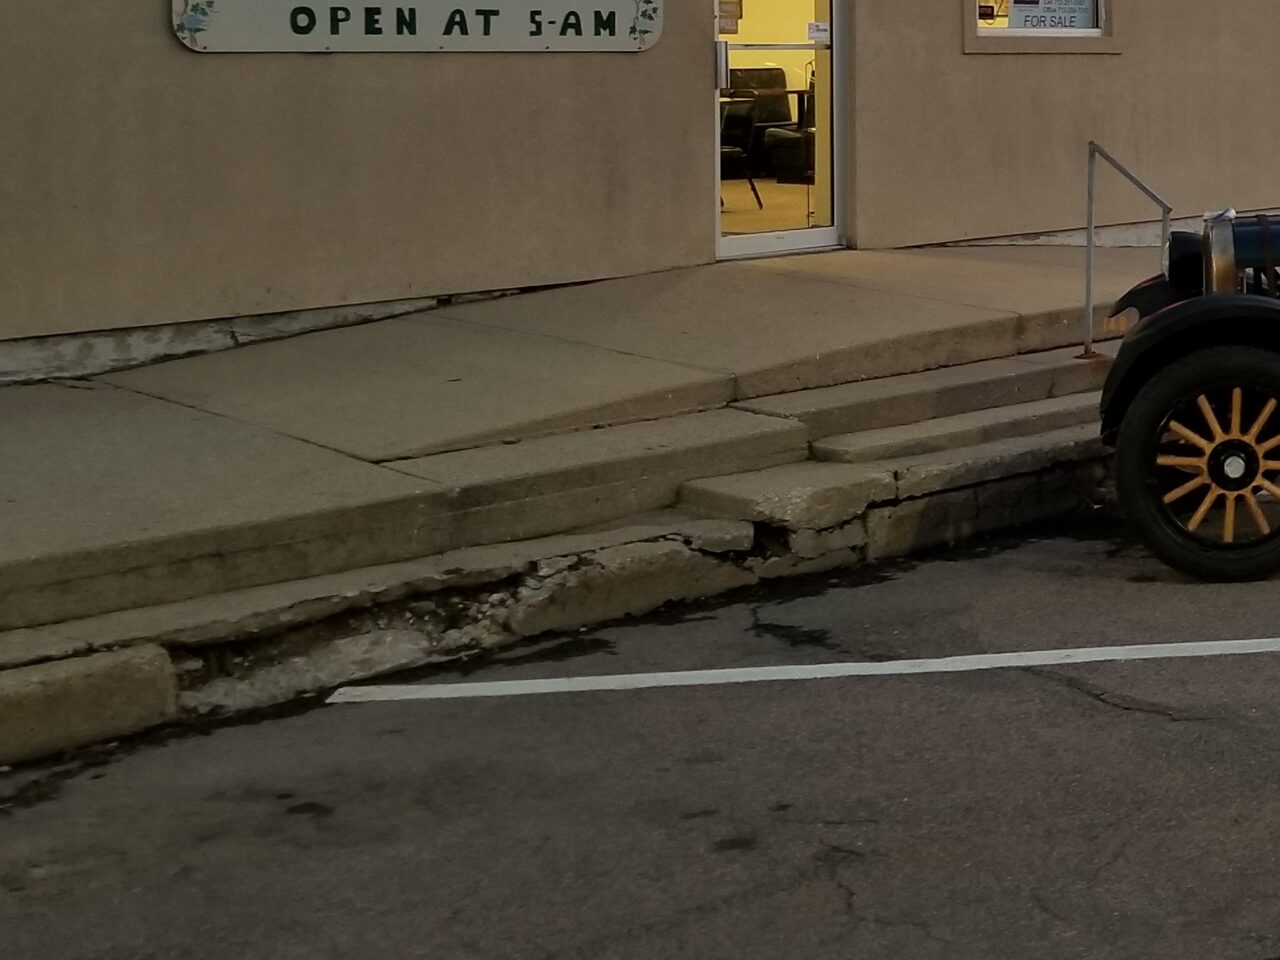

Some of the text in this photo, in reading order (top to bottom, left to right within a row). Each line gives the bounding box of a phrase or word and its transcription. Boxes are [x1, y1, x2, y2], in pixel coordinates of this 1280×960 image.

[290, 6, 617, 37] OPEN AT 5-AM
[1024, 15, 1077, 28] FOR SALE
